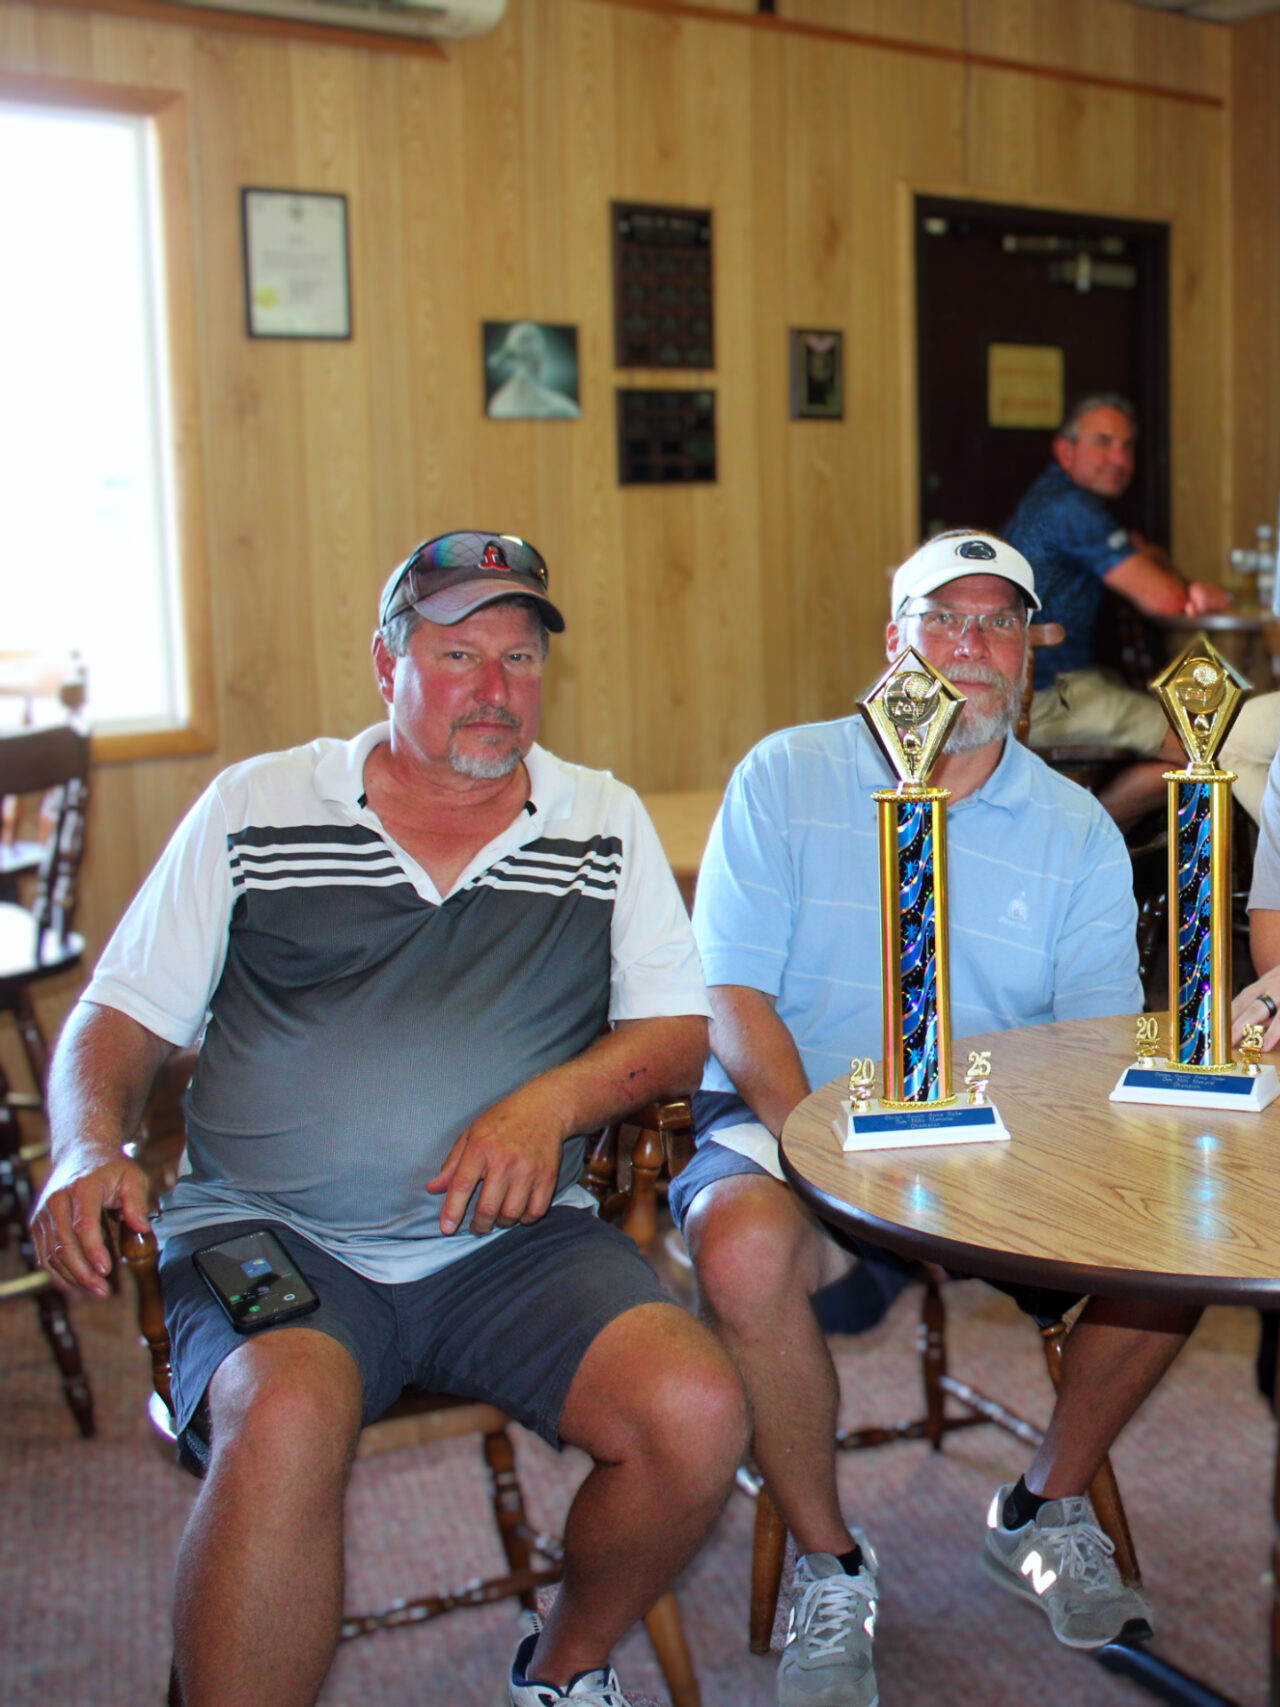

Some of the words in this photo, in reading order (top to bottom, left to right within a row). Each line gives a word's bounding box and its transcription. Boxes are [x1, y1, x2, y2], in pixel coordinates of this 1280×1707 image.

[1136, 1016, 1159, 1039] 20
[1241, 1023, 1264, 1048] 25
[850, 1057, 875, 1081] 20
[967, 1050, 992, 1076] 25
[1020, 1549, 1057, 1595] N
